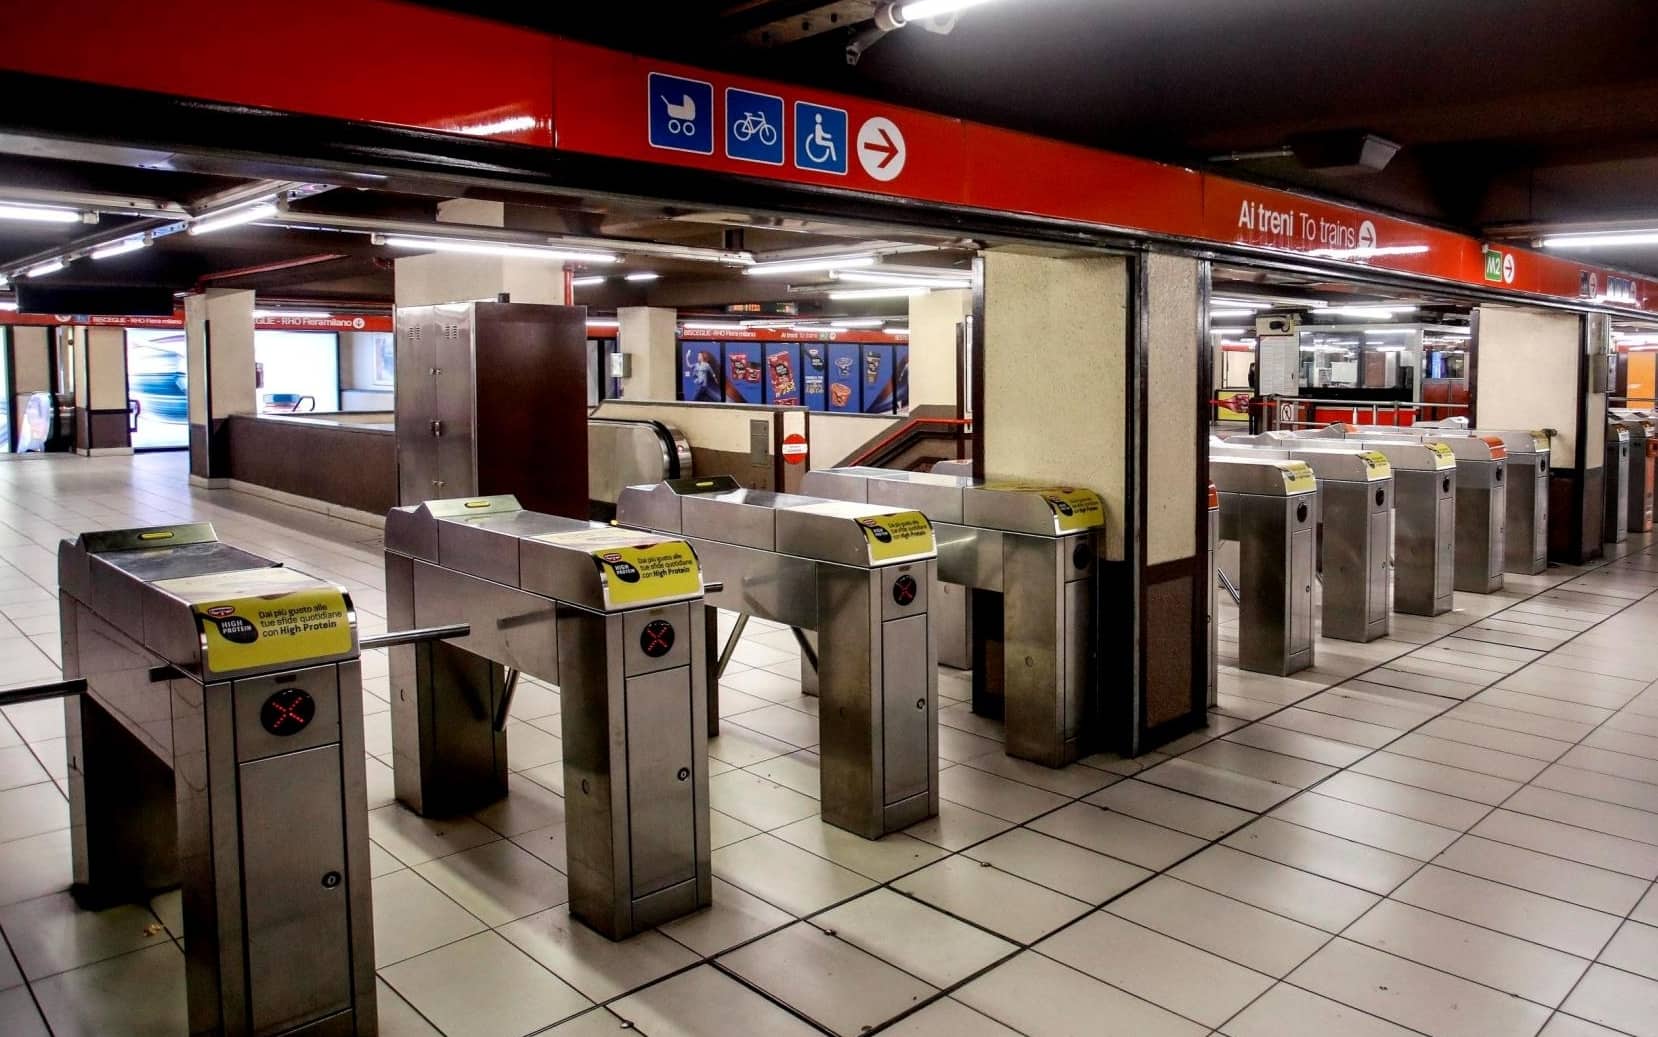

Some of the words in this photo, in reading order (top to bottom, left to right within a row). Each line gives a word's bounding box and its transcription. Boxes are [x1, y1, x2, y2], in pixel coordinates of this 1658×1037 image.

[1238, 200, 1255, 229] Ai
[1258, 204, 1294, 237] treni
[1299, 212, 1316, 241] To
[1320, 217, 1355, 248] trains
[1487, 256, 1500, 275] M2
[260, 619, 276, 628] tue
[276, 616, 298, 625] sfide
[299, 611, 343, 623] quotidiane
[287, 606, 313, 616] gusto
[221, 619, 243, 629] HIGH
[222, 625, 252, 634] PROTEIN
[262, 629, 279, 637] con
[280, 624, 301, 635] High
[303, 620, 337, 632] Protein
